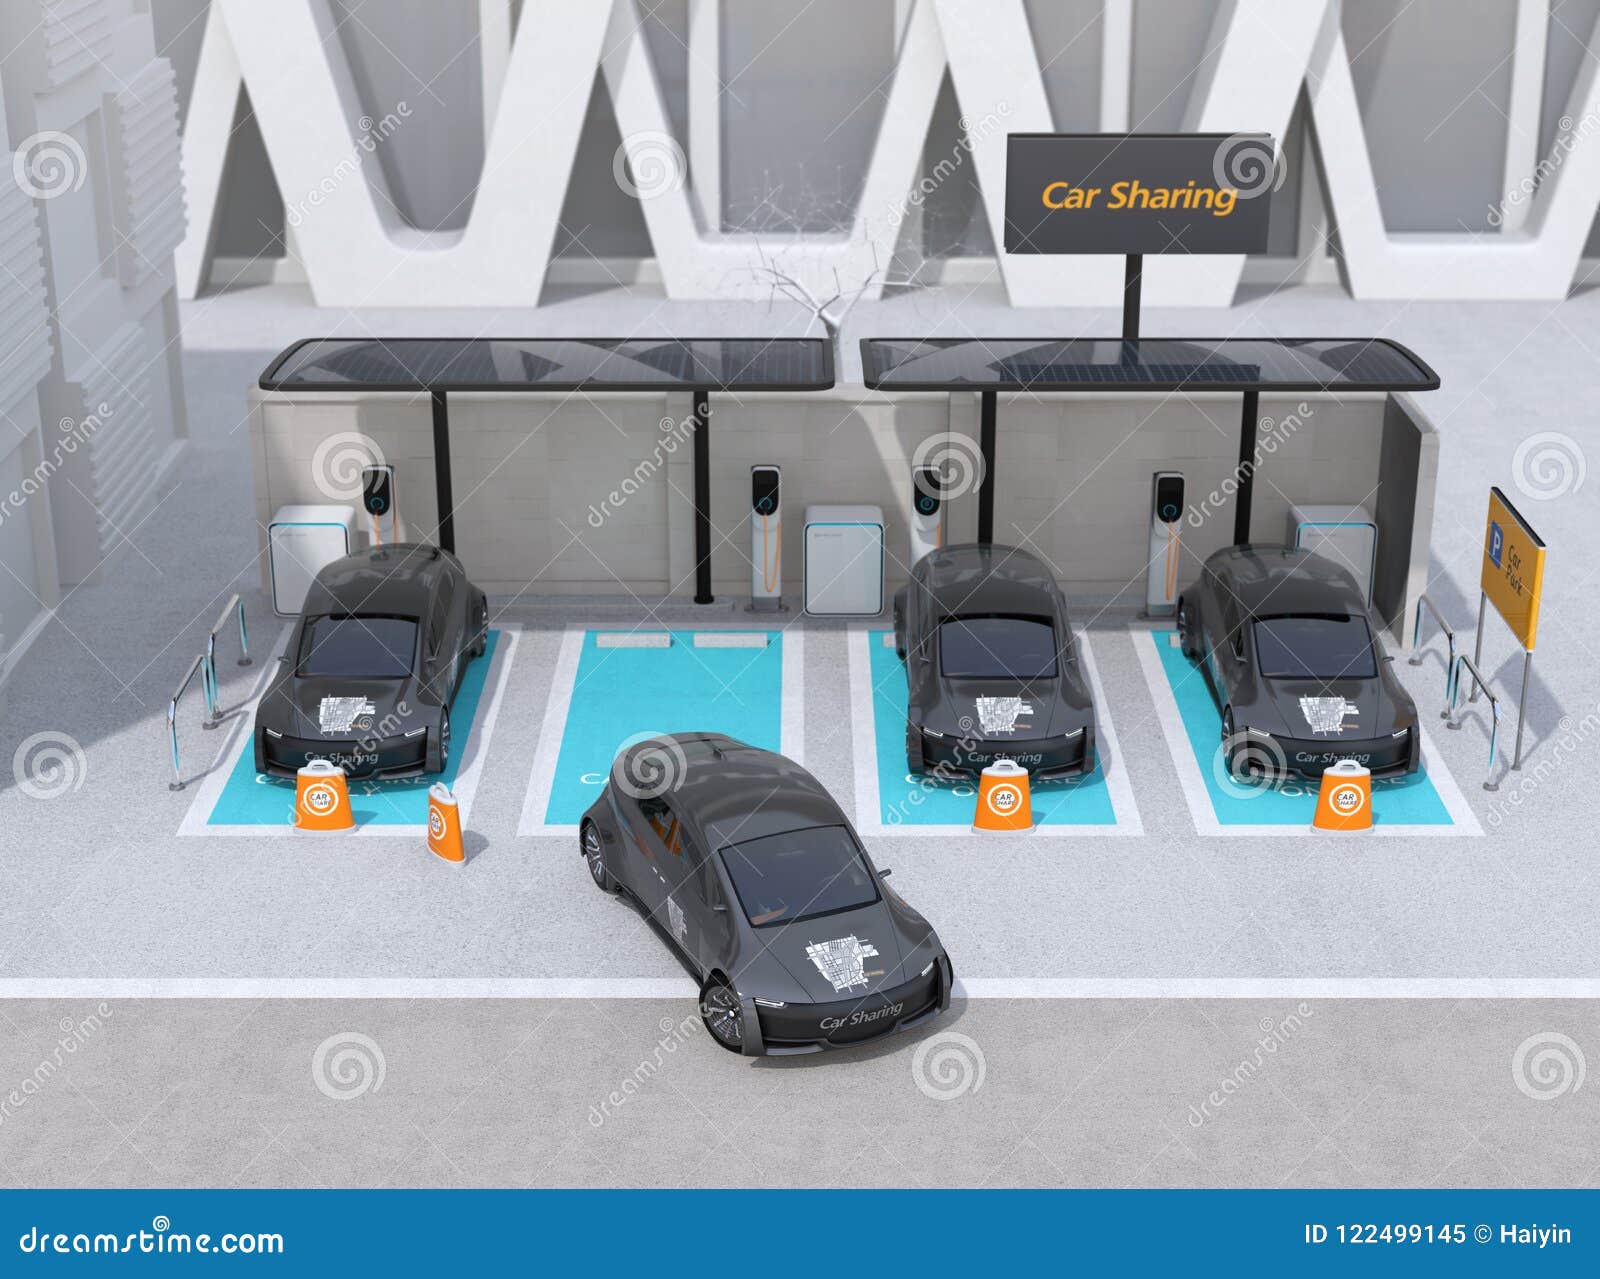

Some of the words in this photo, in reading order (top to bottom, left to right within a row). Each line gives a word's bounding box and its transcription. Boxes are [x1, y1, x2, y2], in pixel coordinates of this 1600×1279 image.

[1042, 181, 1101, 210] Car
[1106, 179, 1239, 217] Sharing
[1507, 545, 1522, 571] Car
[1505, 564, 1524, 596] Park
[304, 751, 327, 762] Car
[329, 751, 379, 765] Sharing
[967, 751, 991, 763] Car
[1295, 751, 1320, 763] Car
[310, 793, 328, 801] CAR
[994, 793, 1013, 801] CAR
[1336, 793, 1355, 801] CAR
[820, 1016, 847, 1030] Car
[850, 1002, 904, 1026] Sharing
